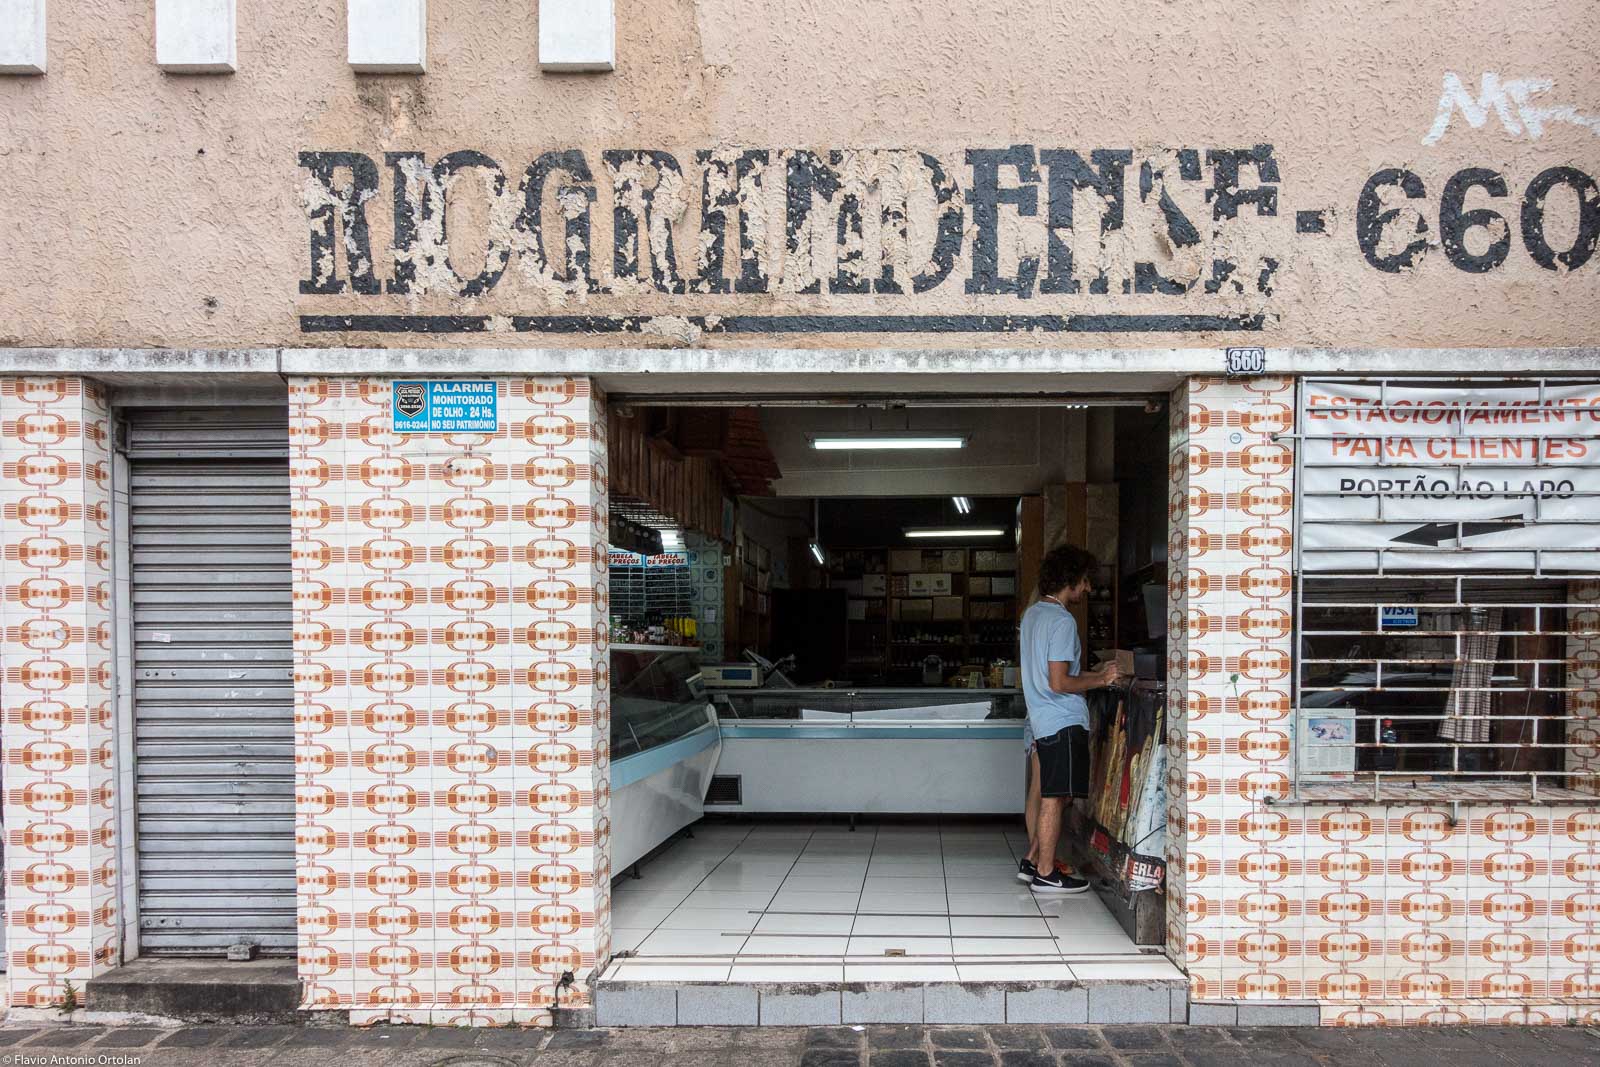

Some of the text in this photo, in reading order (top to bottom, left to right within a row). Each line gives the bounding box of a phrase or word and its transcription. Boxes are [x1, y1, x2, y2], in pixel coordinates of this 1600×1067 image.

[1356, 166, 1600, 274] 660
[1230, 351, 1263, 371] 660
[433, 383, 493, 393] ALARME
[432, 395, 494, 405] MONITORADO
[432, 406, 442, 418] DE
[443, 406, 464, 418] OLHO
[470, 406, 480, 418] 24
[481, 406, 494, 418] Hs.
[431, 420, 441, 430] NO
[442, 420, 455, 430] SEU
[1332, 432, 1587, 459] PARA CLIENTES
[1340, 475, 1575, 500] PORTÃO AO LADO
[1383, 606, 1414, 616] VISA
